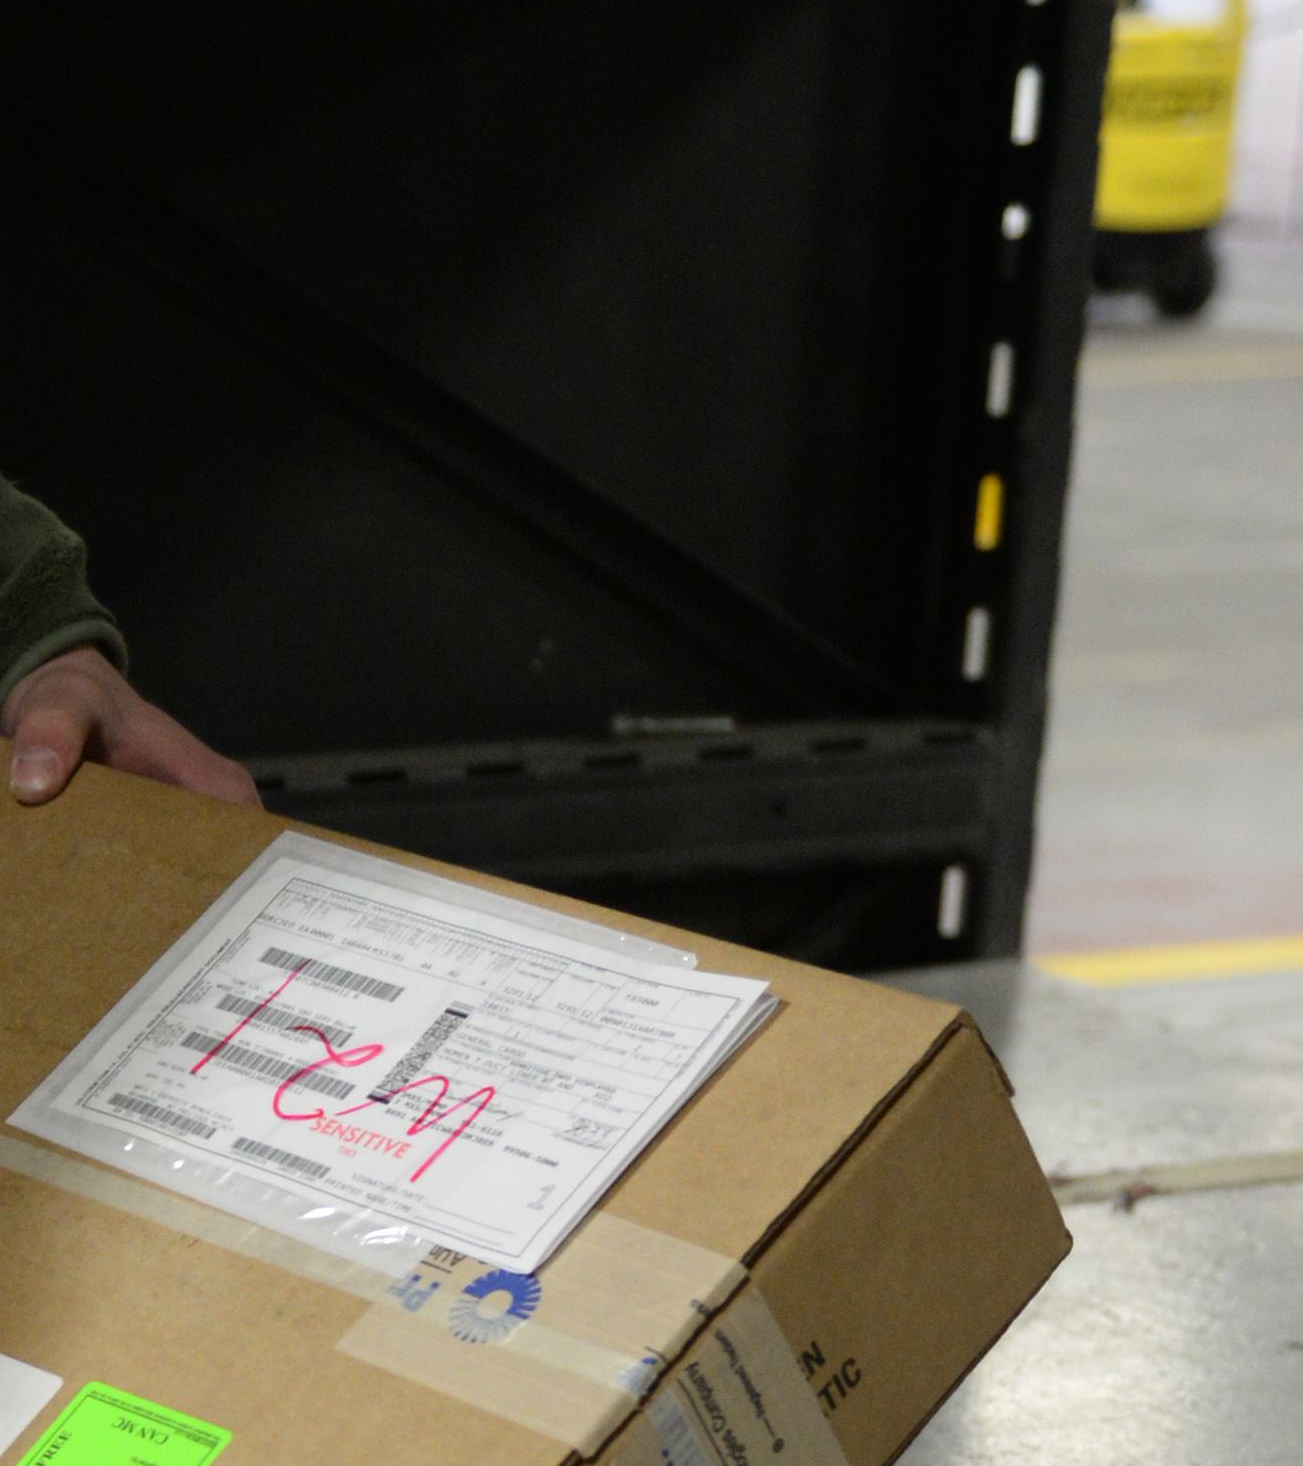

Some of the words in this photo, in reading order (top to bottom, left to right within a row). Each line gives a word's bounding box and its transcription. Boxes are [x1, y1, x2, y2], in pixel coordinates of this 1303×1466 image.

[308, 1114, 414, 1160] SENSITIVE
[684, 1356, 728, 1436] Company
[109, 1415, 139, 1434] MC
[133, 1424, 171, 1446] CAN
